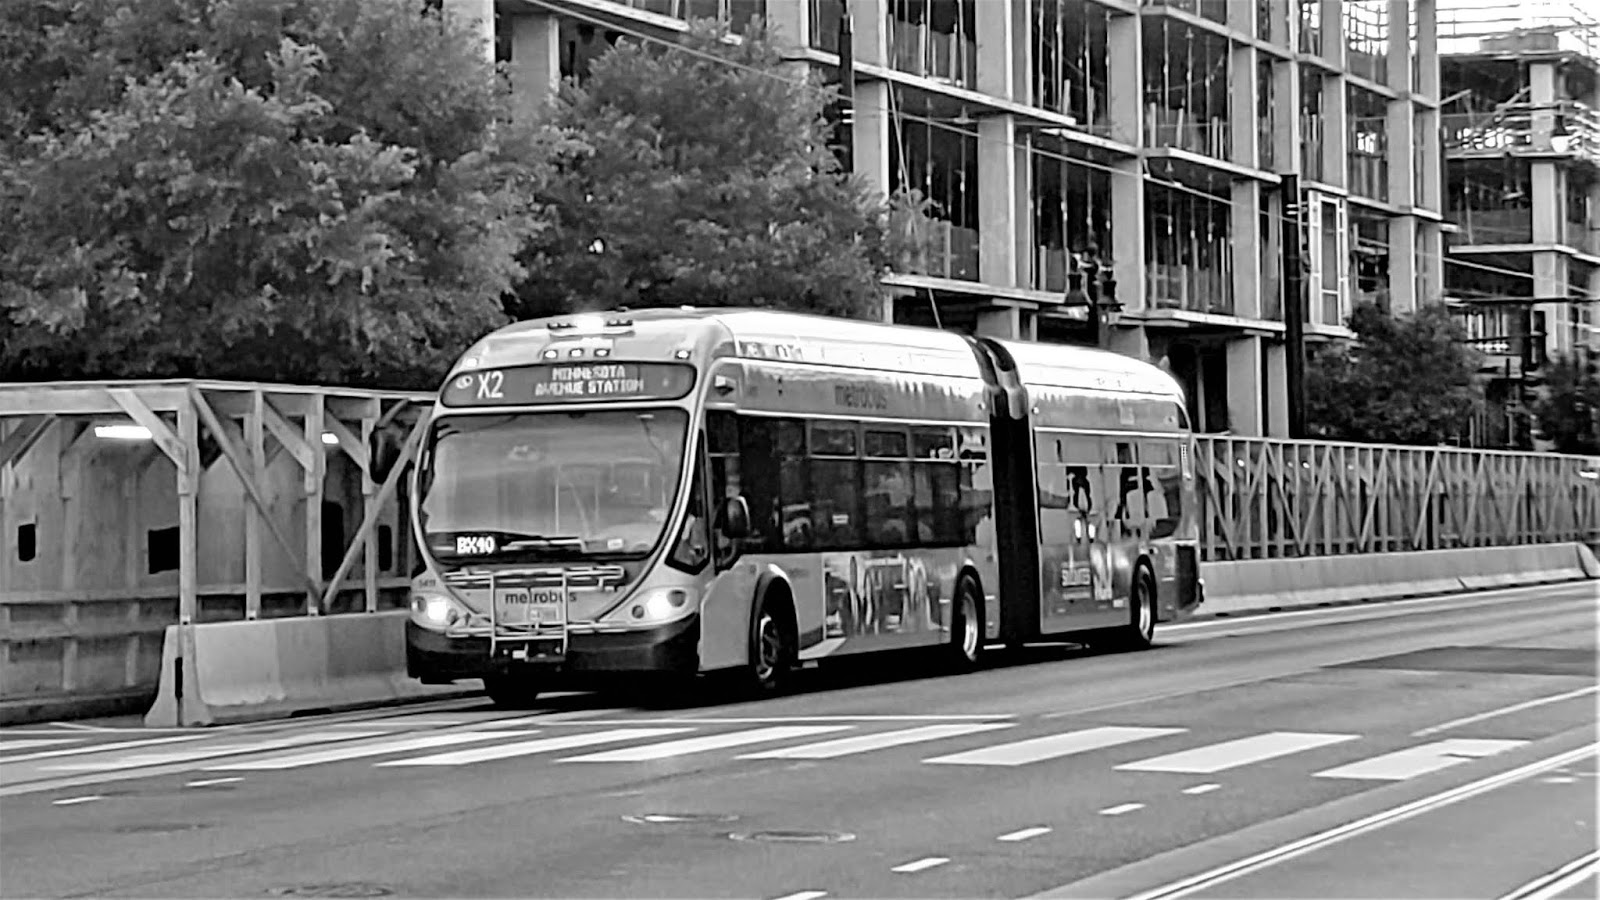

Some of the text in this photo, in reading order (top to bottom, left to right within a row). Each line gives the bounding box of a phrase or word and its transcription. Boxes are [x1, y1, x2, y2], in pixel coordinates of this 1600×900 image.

[552, 365, 625, 380] MINNESOTA
[477, 371, 504, 399] X2
[535, 379, 643, 396] AVENUE STATION
[456, 536, 496, 554] BX40
